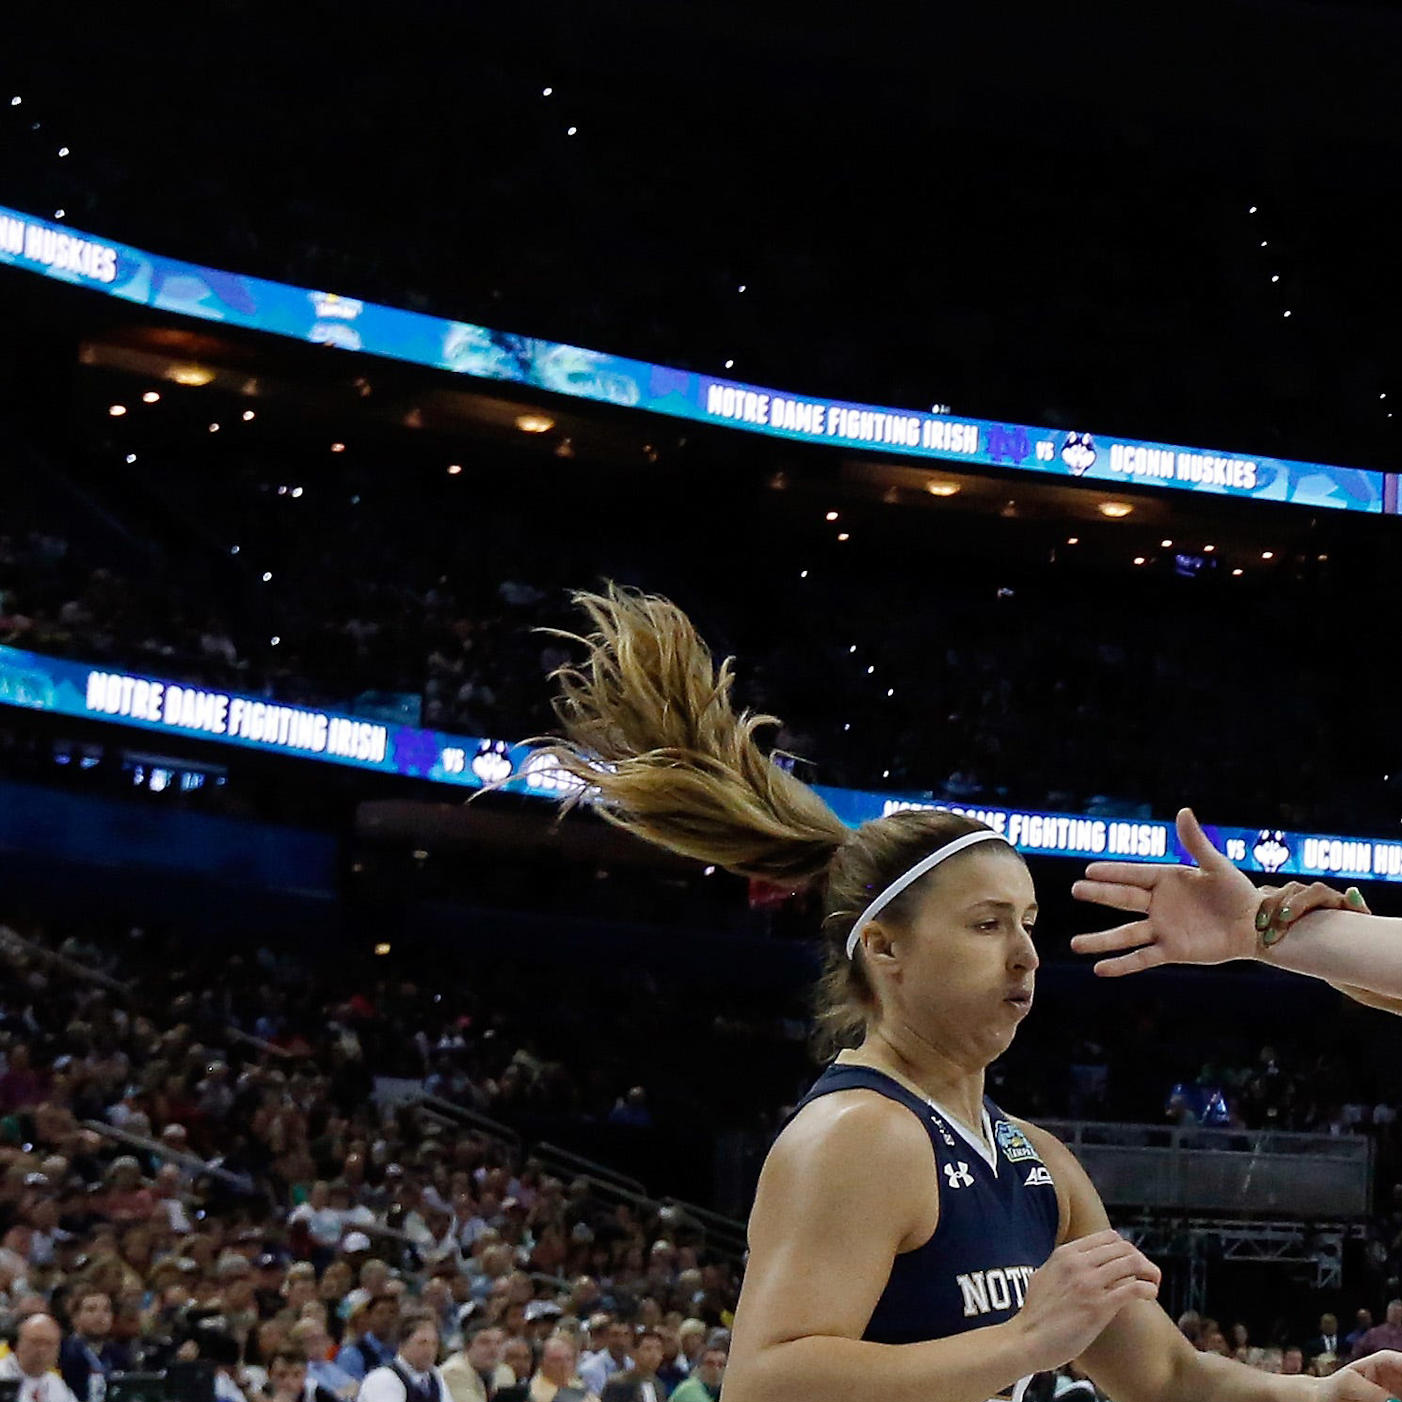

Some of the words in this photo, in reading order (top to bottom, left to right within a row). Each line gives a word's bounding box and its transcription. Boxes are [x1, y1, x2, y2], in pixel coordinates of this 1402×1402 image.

[24, 224, 118, 284] HUSKIES
[708, 384, 769, 425] NOTRE
[770, 398, 825, 435] DAME
[827, 407, 920, 447] FIGHTING
[923, 420, 979, 454] IRISH
[1035, 441, 1055, 462] VS
[1110, 444, 1174, 478] UCONN
[1176, 452, 1257, 489] HUSKIES
[86, 670, 164, 722] NOTRE
[163, 685, 229, 733] DAME
[227, 698, 328, 753] FIGHTING
[327, 718, 387, 763] IRISH
[1009, 814, 1106, 853] FIGHTING
[1109, 822, 1166, 857] IRISH
[1226, 839, 1246, 861] VS
[1303, 838, 1371, 872] UCONN
